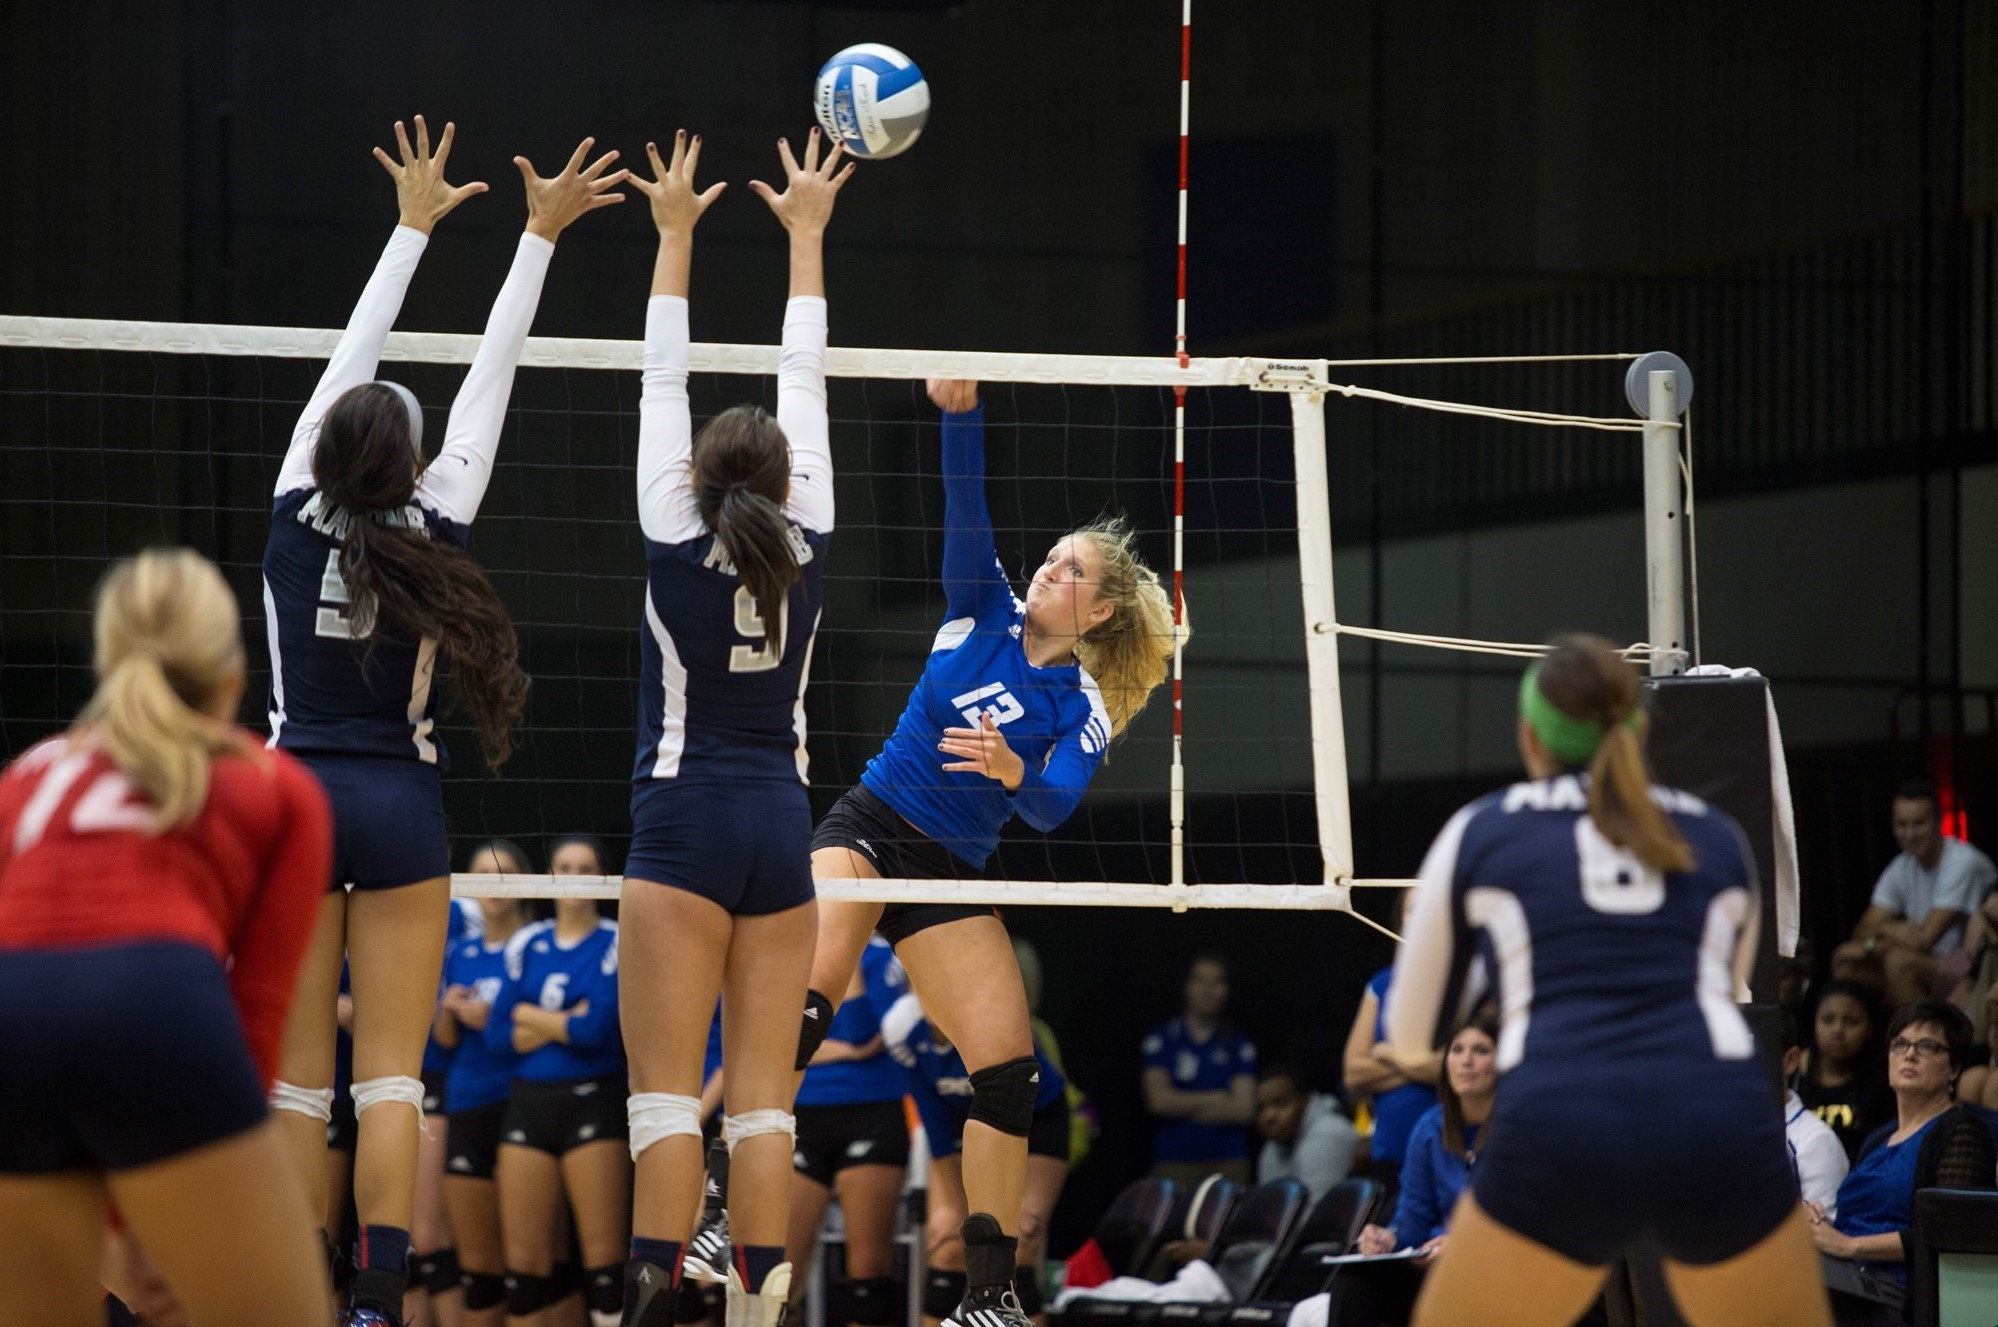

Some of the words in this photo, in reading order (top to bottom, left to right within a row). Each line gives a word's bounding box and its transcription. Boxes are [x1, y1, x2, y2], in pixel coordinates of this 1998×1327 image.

[834, 89, 862, 140] NCAA
[729, 585, 789, 673] 9
[951, 681, 1025, 735] 13
[1575, 813, 1666, 915] 6
